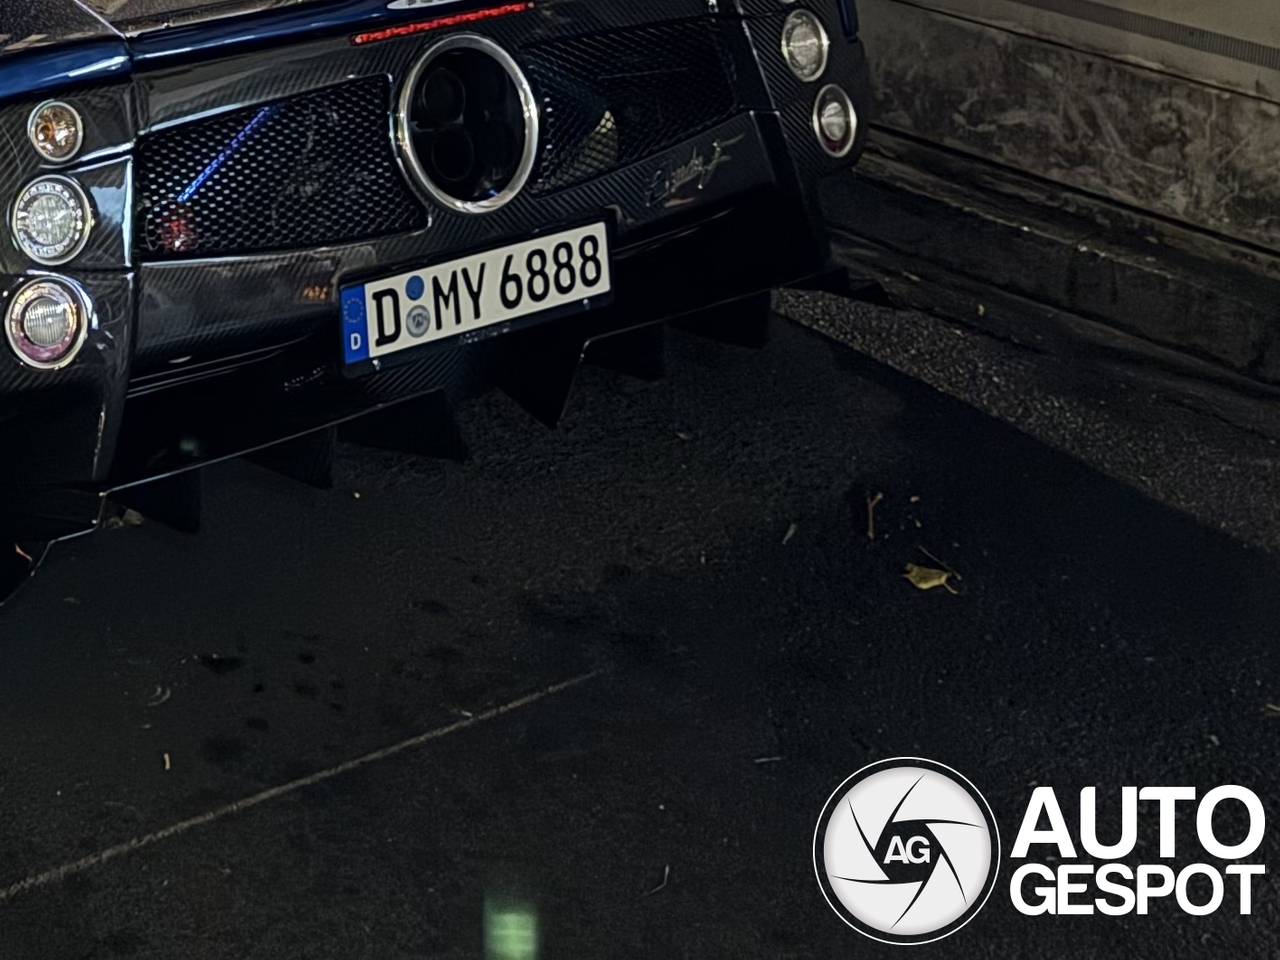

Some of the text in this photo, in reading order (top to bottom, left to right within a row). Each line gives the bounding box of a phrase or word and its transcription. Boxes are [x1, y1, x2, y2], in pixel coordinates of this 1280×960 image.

[372, 234, 602, 347] D MY 6888
[350, 332, 361, 350] D
